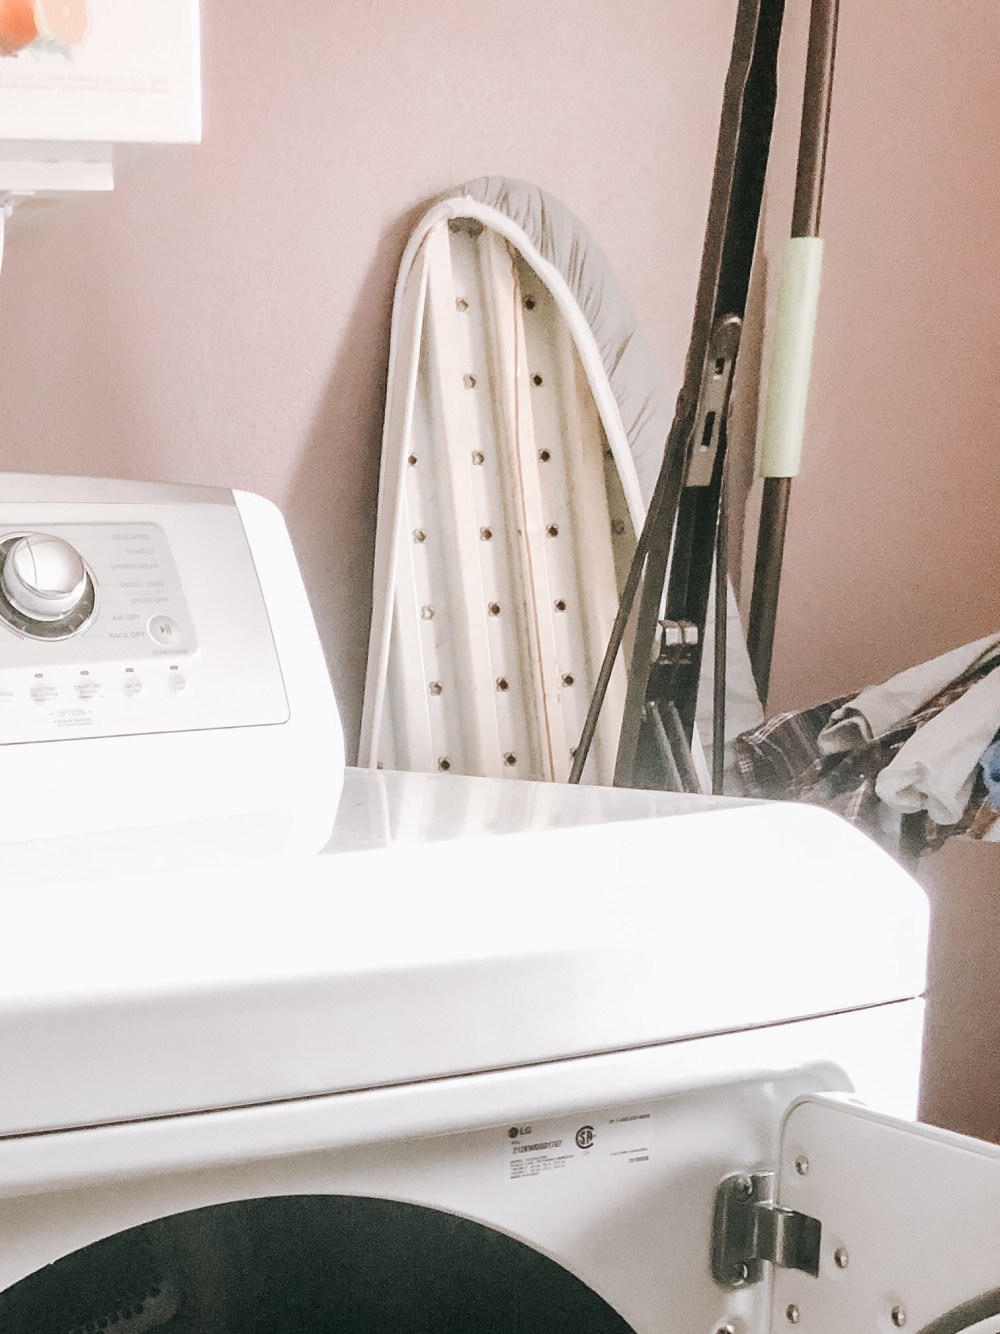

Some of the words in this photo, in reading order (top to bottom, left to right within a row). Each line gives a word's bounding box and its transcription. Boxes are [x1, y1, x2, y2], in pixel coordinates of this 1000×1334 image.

[154, 596, 169, 604] DRY
[57, 709, 85, 718] OPTION
[519, 1126, 531, 1135] LG
